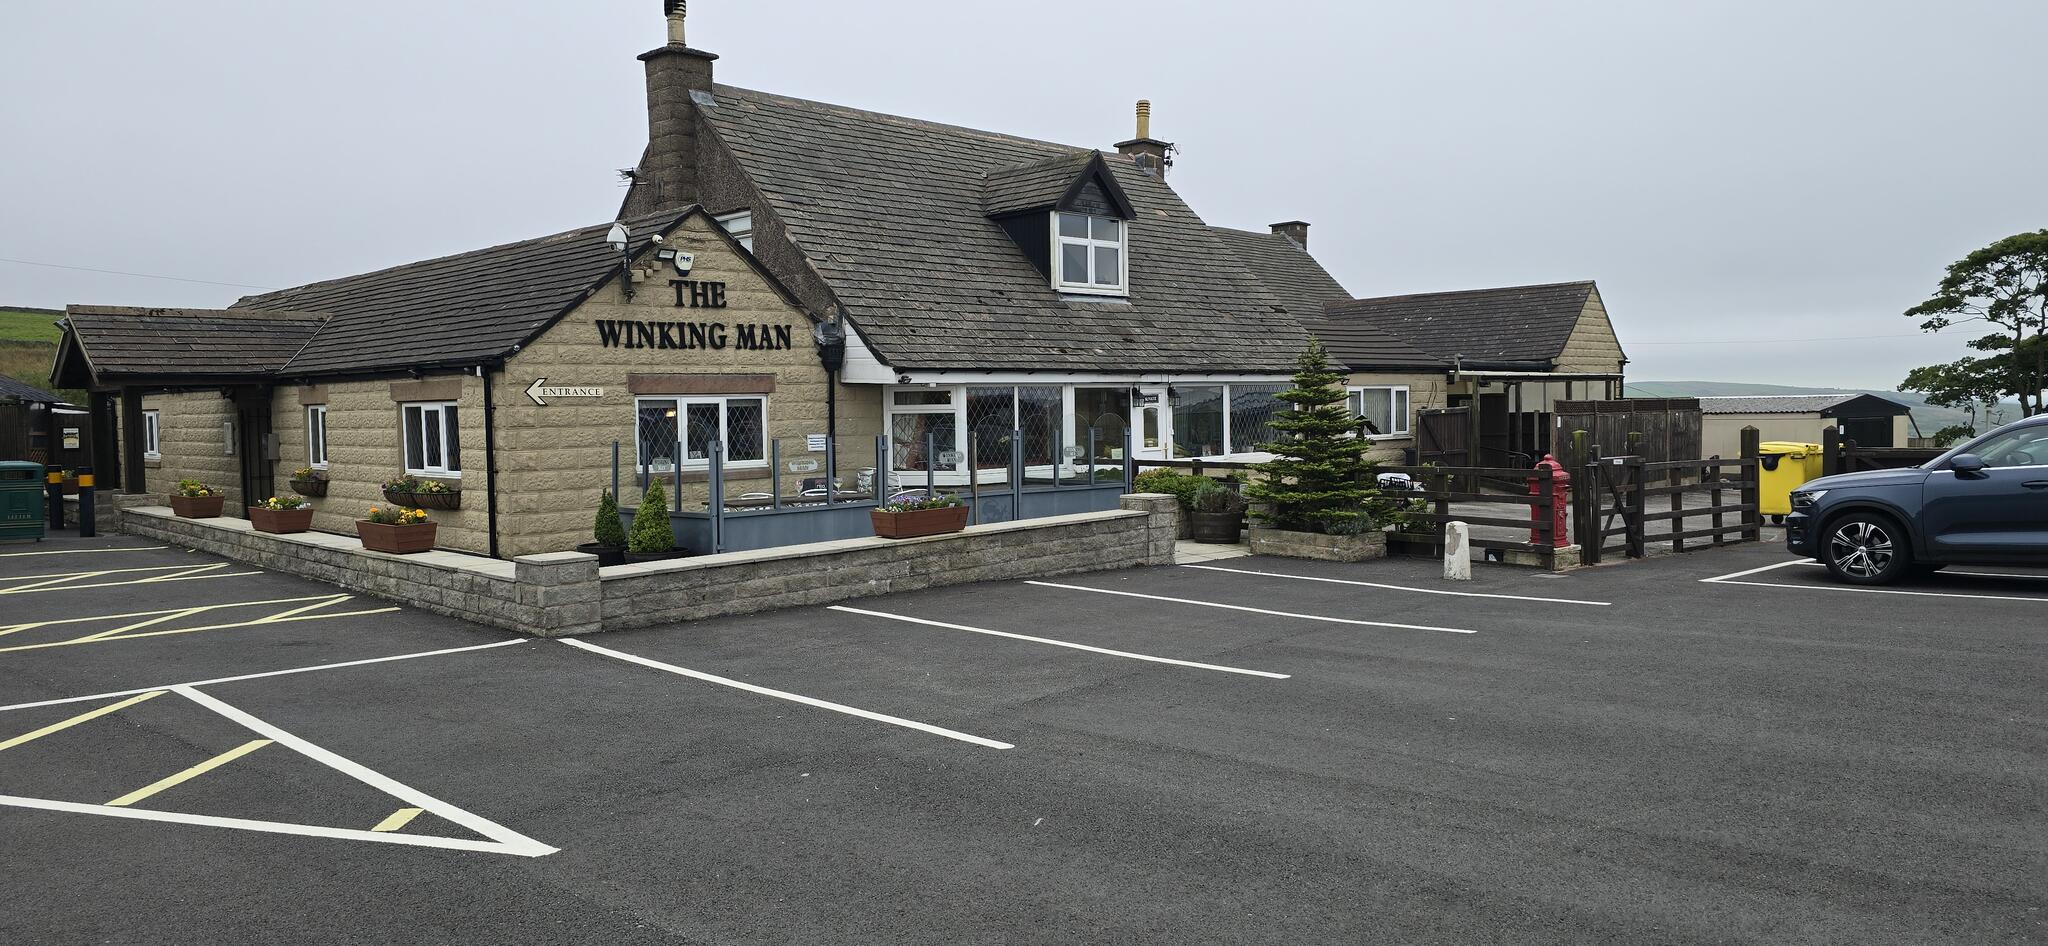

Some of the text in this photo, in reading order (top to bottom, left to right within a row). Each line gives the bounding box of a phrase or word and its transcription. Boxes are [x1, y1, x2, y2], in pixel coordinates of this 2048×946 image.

[668, 279, 727, 309] THE
[595, 319, 792, 351] WINKING MAN
[542, 387, 601, 396] ENTRANCE
